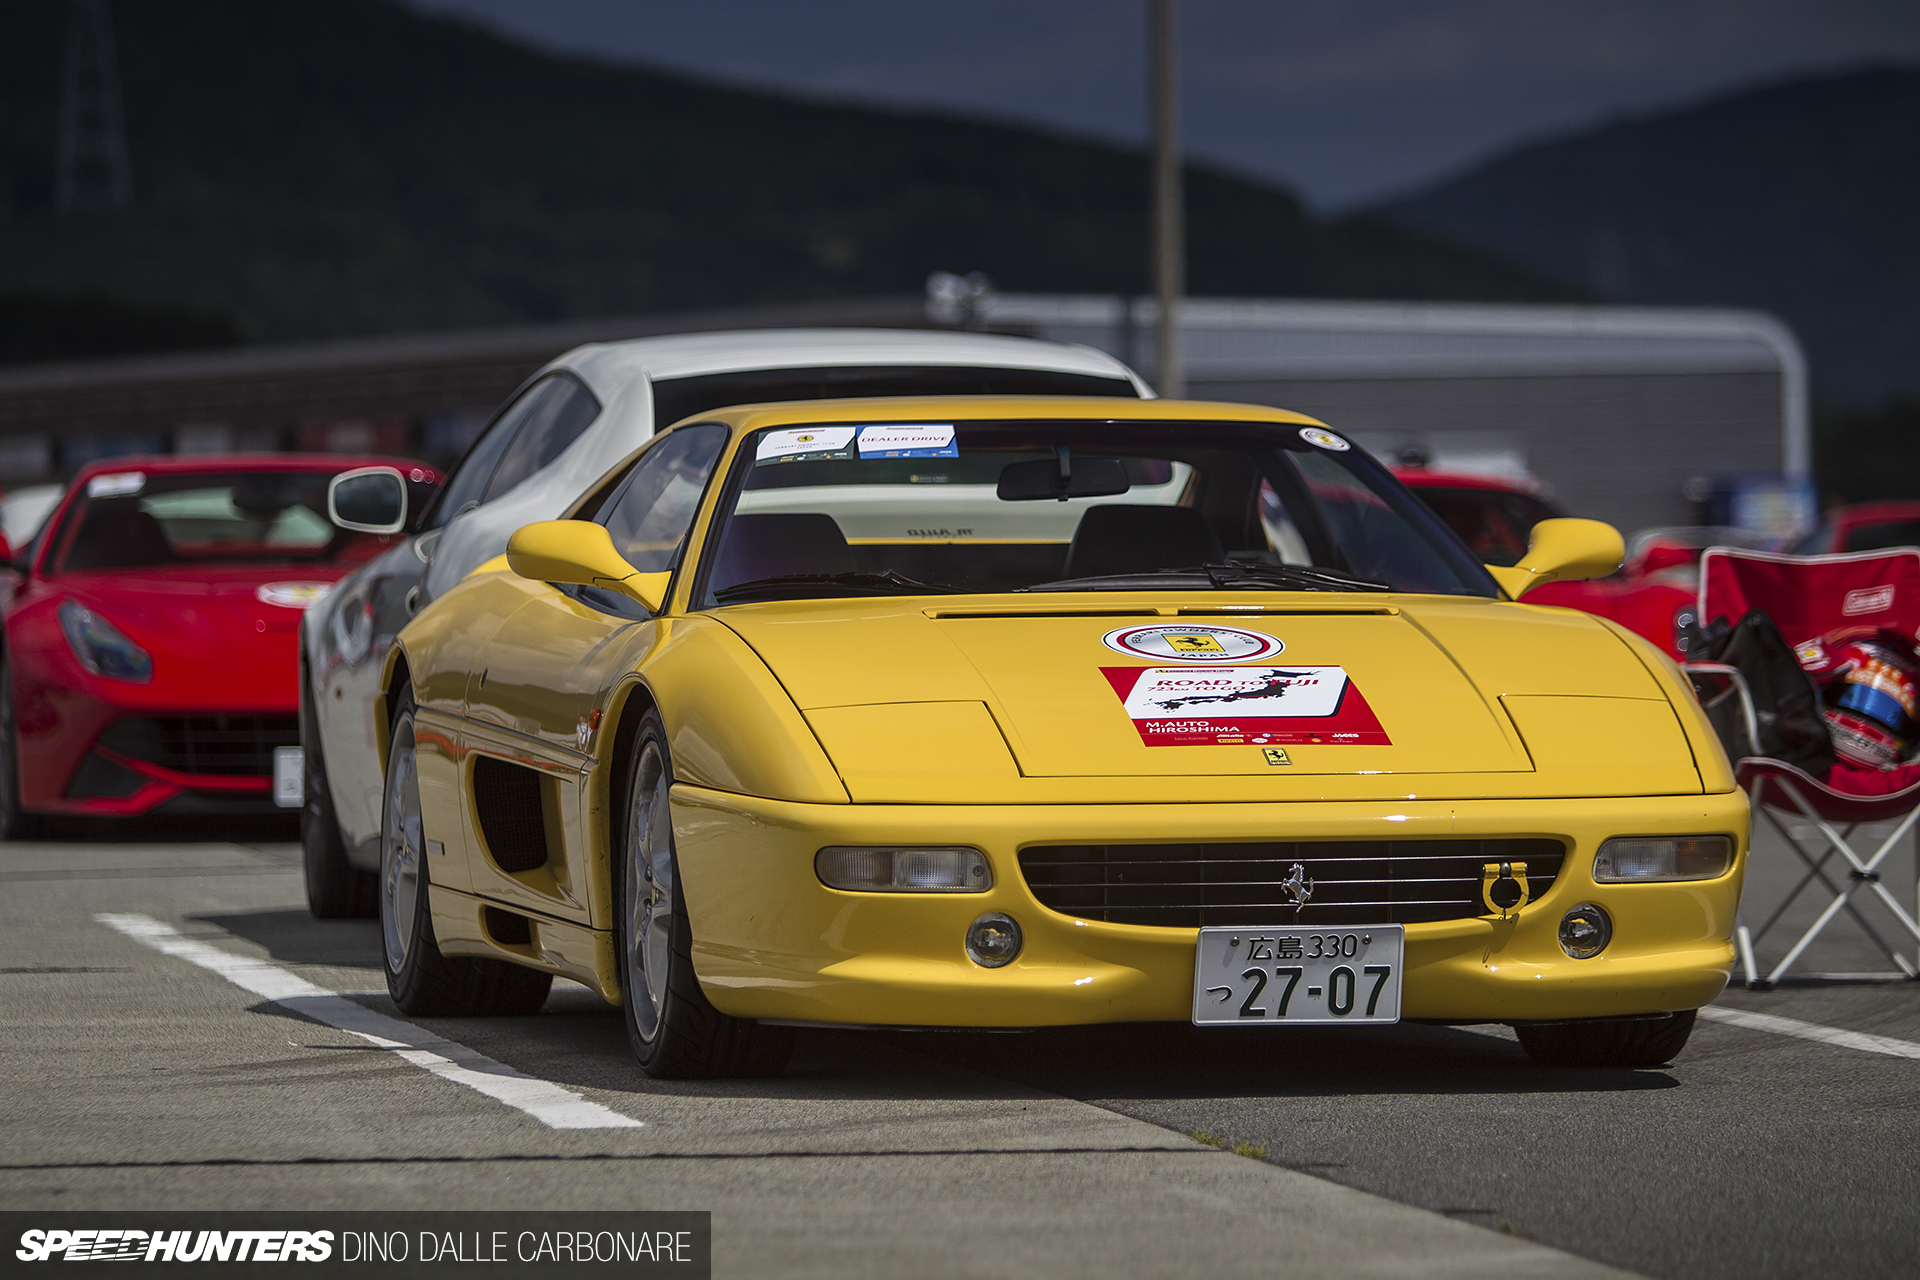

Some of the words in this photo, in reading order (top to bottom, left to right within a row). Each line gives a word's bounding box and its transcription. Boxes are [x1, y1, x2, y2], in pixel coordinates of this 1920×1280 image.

[1156, 679, 1232, 687] ROAD
[1269, 679, 1320, 687] FUJI
[1149, 726, 1240, 734] HIROSHIMA
[1247, 935, 1304, 960] 広島
[1307, 933, 1358, 959] 330
[1206, 985, 1233, 1002] つ
[1239, 964, 1391, 1017] 27-07
